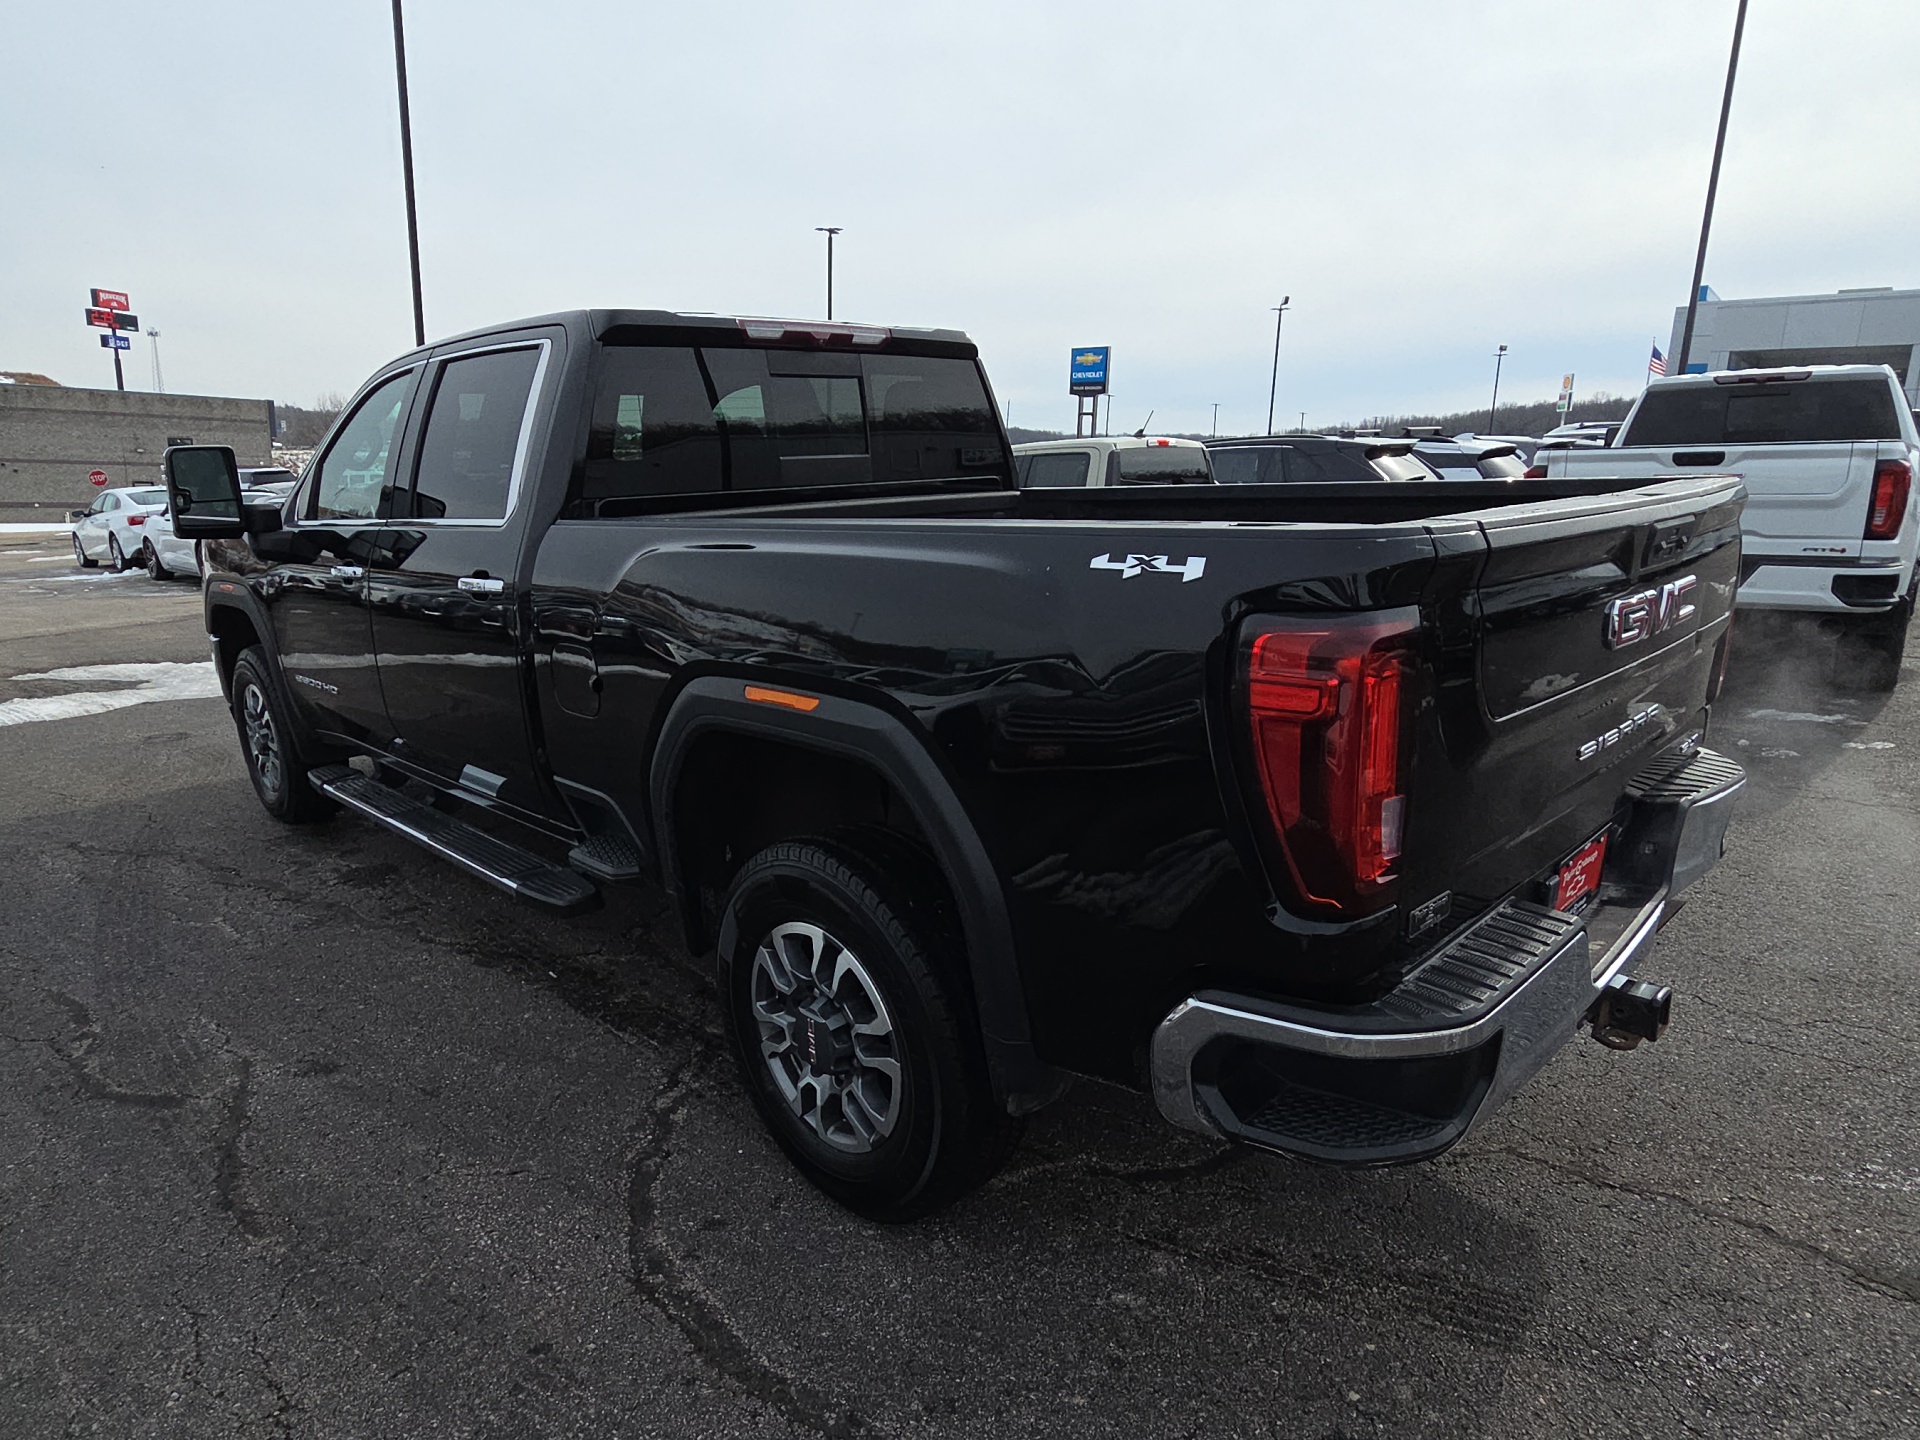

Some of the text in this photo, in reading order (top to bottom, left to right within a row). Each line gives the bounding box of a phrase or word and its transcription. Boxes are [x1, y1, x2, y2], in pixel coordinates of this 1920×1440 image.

[1072, 371, 1103, 379] CHEVROLET
[90, 474, 106, 483] STOP
[1606, 574, 1697, 651] GMC
[1577, 703, 1659, 761] SIERRA
